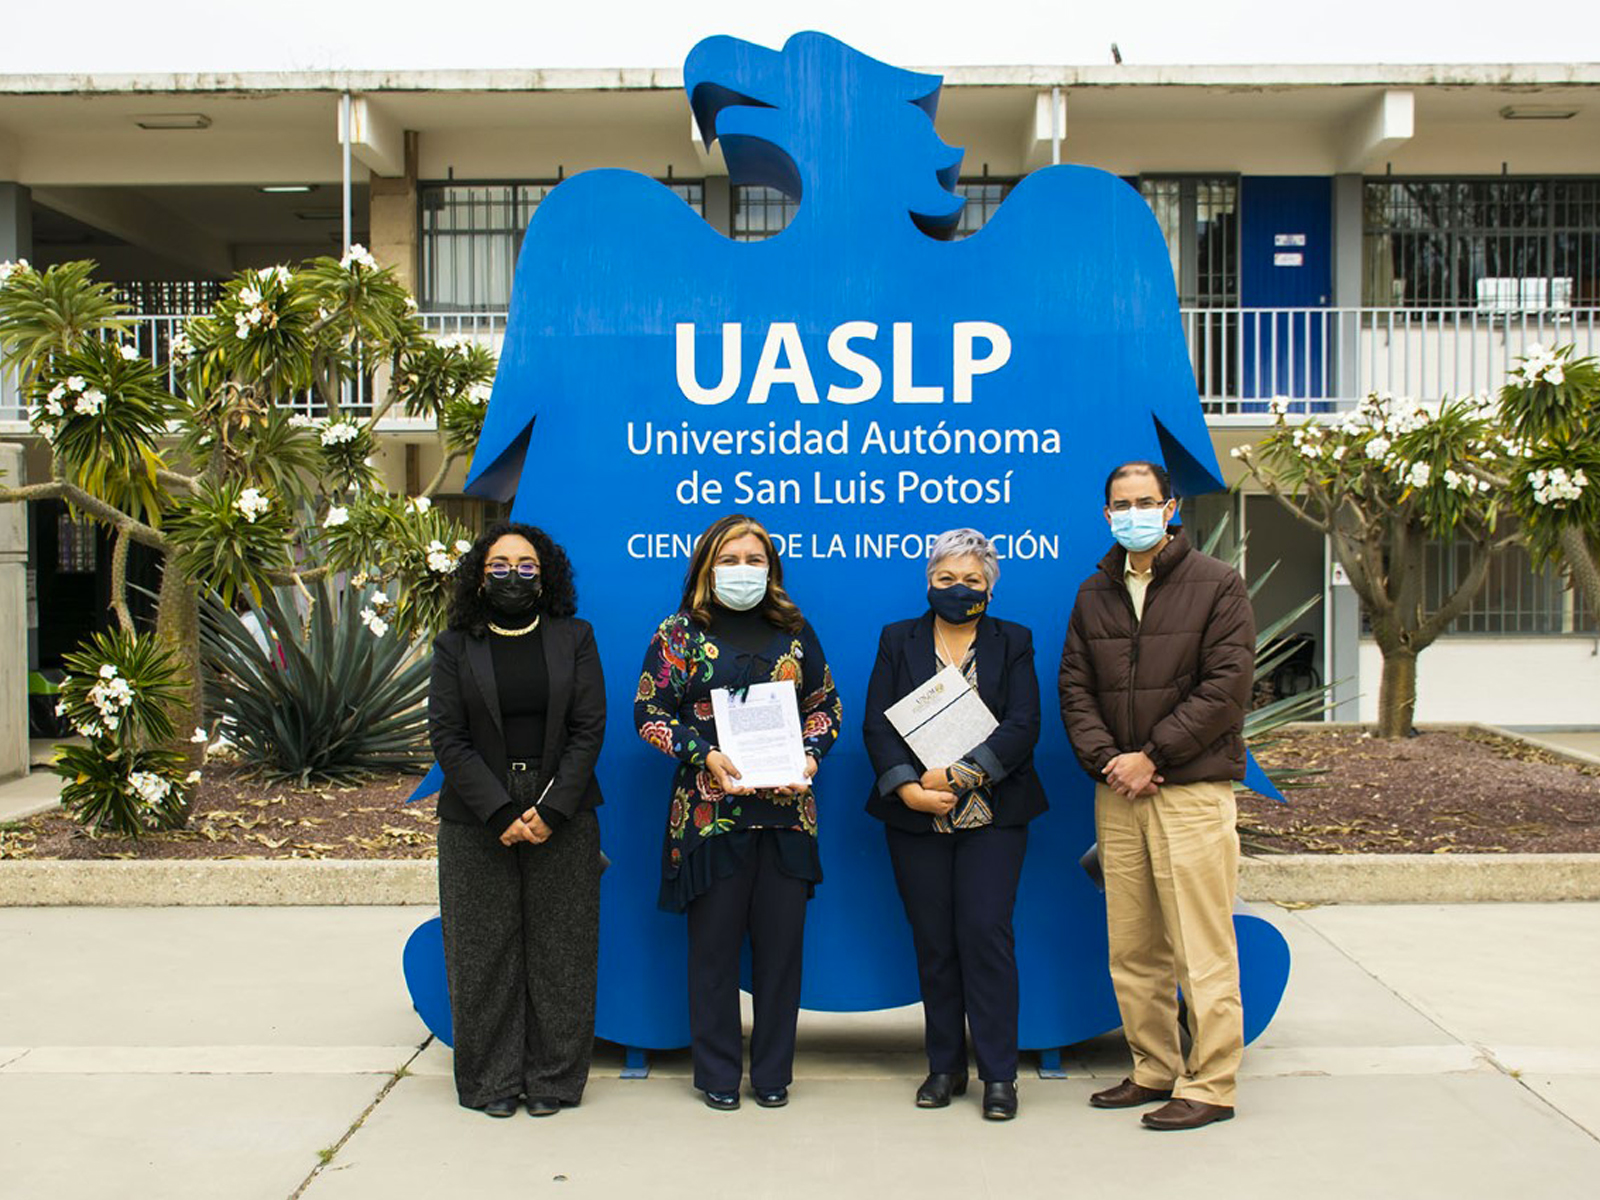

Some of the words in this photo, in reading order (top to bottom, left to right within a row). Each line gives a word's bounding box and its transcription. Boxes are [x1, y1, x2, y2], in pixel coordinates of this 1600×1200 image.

[676, 321, 1012, 405] UASLP
[627, 420, 849, 455] Universidad
[861, 420, 1061, 455] Autónoma
[676, 470, 723, 505] de
[735, 471, 801, 505] San
[815, 471, 886, 505] Luis
[898, 469, 1014, 505] Potosí
[812, 534, 847, 558] LA
